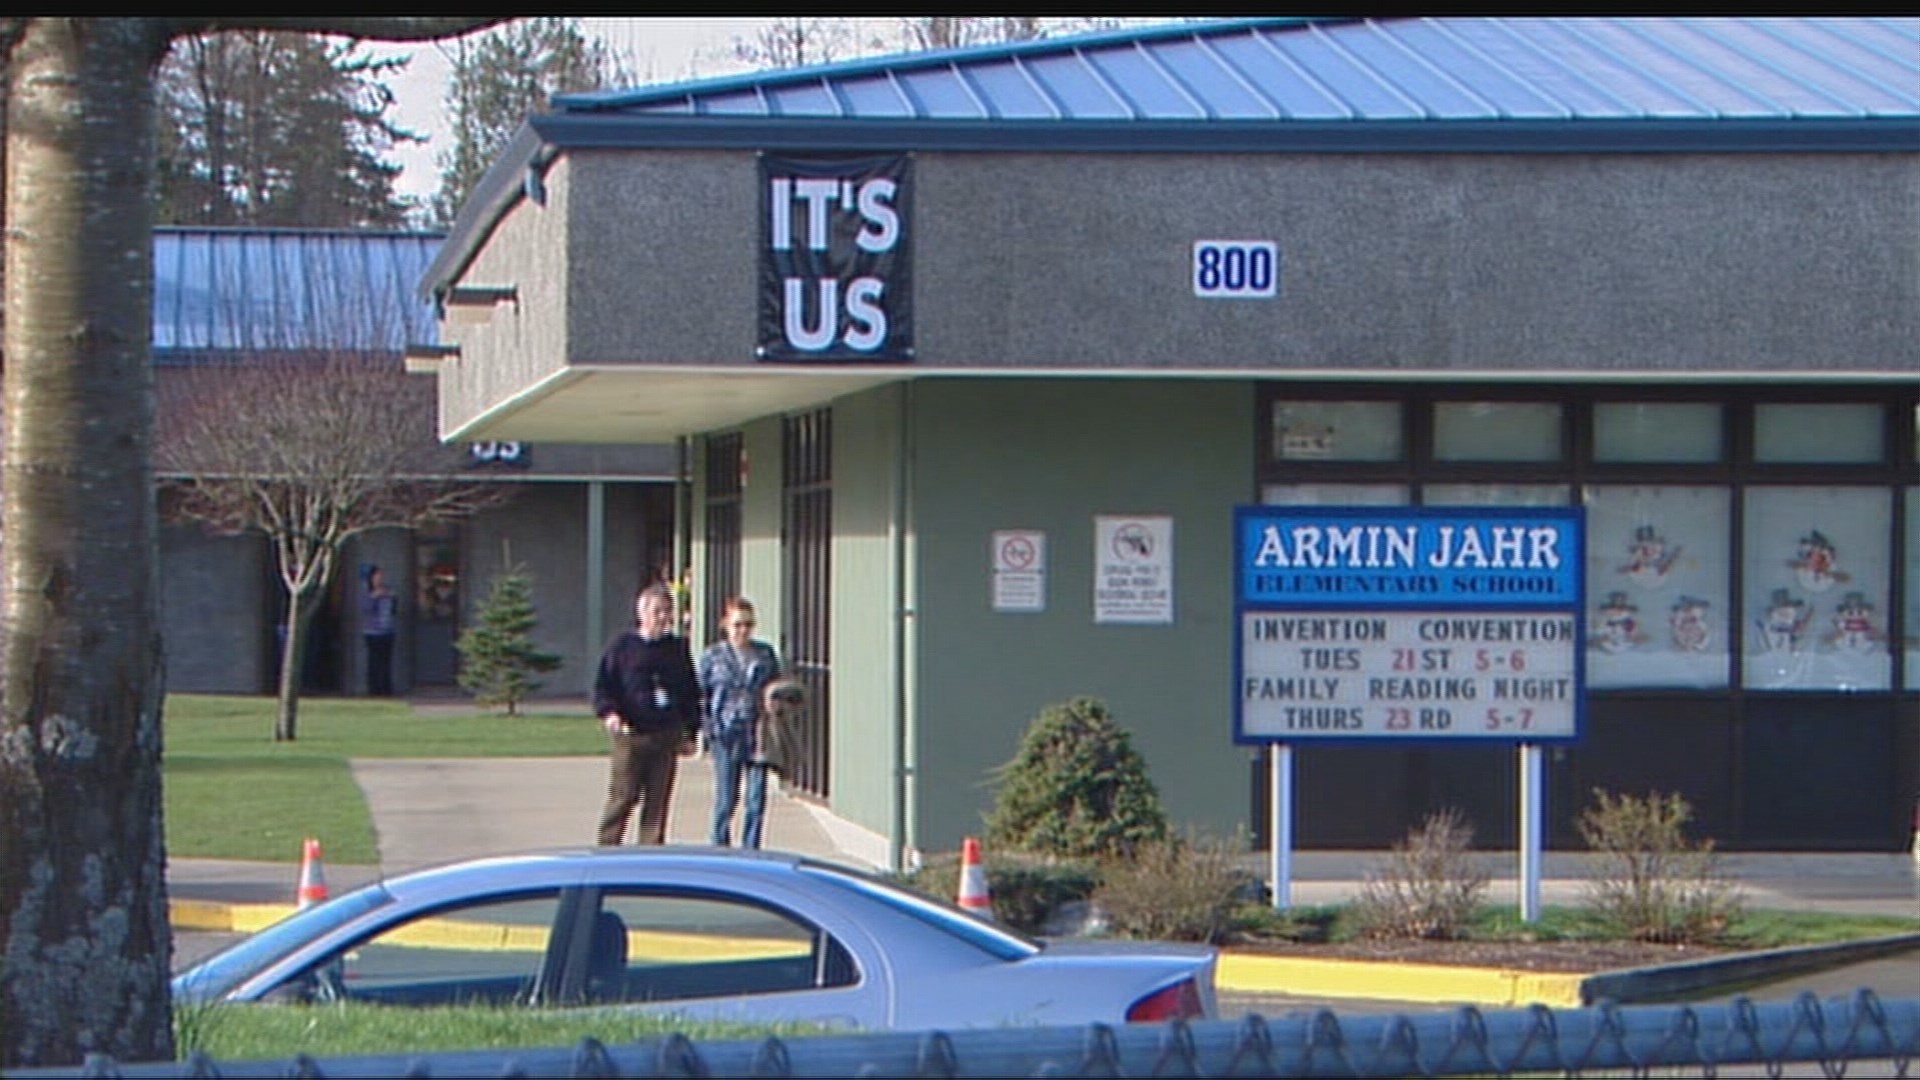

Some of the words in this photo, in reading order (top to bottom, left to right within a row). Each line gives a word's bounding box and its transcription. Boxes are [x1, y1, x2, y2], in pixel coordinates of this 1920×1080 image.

[772, 177, 899, 252] IT'S
[1199, 246, 1271, 291] 800
[784, 276, 887, 350] US
[1254, 525, 1418, 568] ARMIN
[1428, 526, 1560, 569] JAHR
[1255, 575, 1440, 593] ELEMENTARY
[1452, 575, 1562, 593] SCHOOL
[1254, 618, 1387, 641] INVENTION
[1418, 618, 1573, 641] CONVENTION
[1301, 648, 1360, 671] TUES
[1246, 677, 1339, 699] FAMILY
[1369, 677, 1477, 699] READING
[1493, 677, 1569, 699] NIGHT
[1284, 707, 1364, 730] THURS
